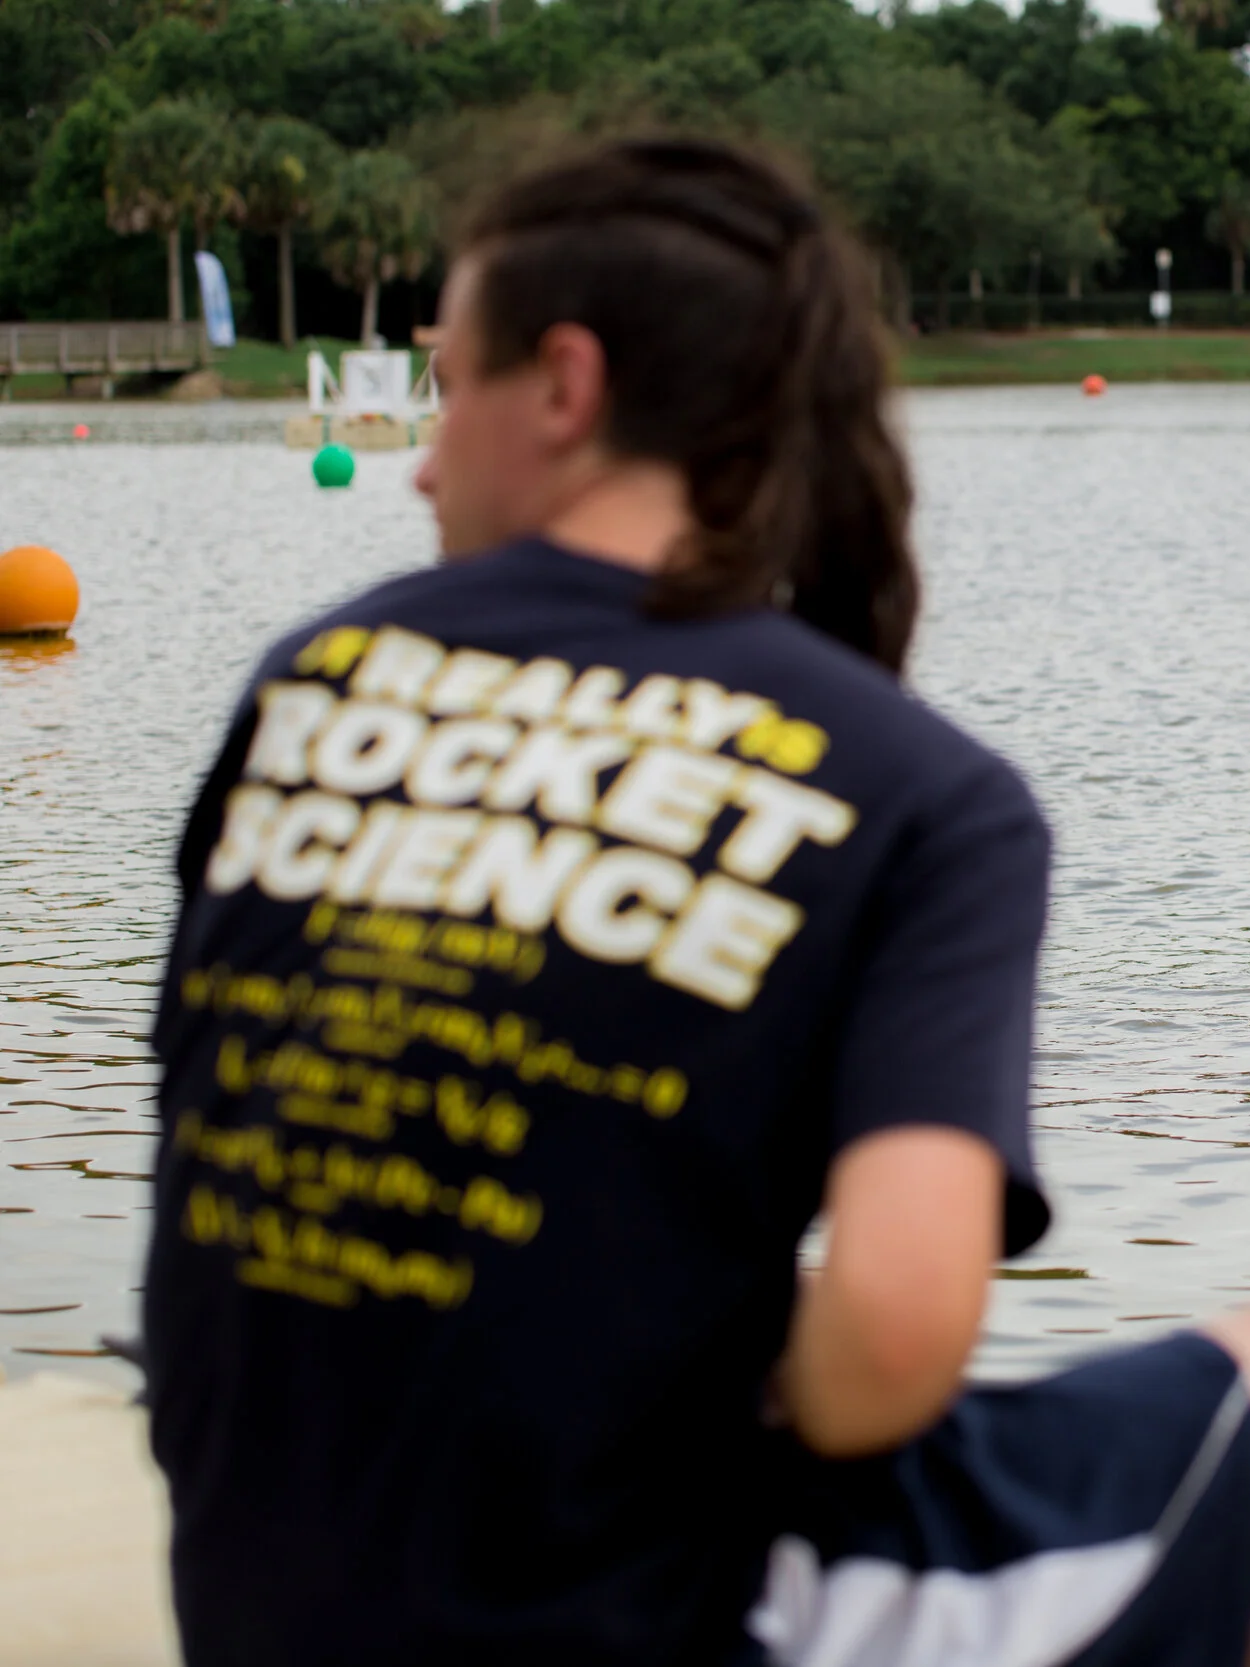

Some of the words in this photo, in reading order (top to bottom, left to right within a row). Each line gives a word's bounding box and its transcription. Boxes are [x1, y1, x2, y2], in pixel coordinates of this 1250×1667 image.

[246, 680, 857, 884] ROCKET
[348, 624, 778, 750] REALLY
[206, 784, 801, 1012] SCIENCE
